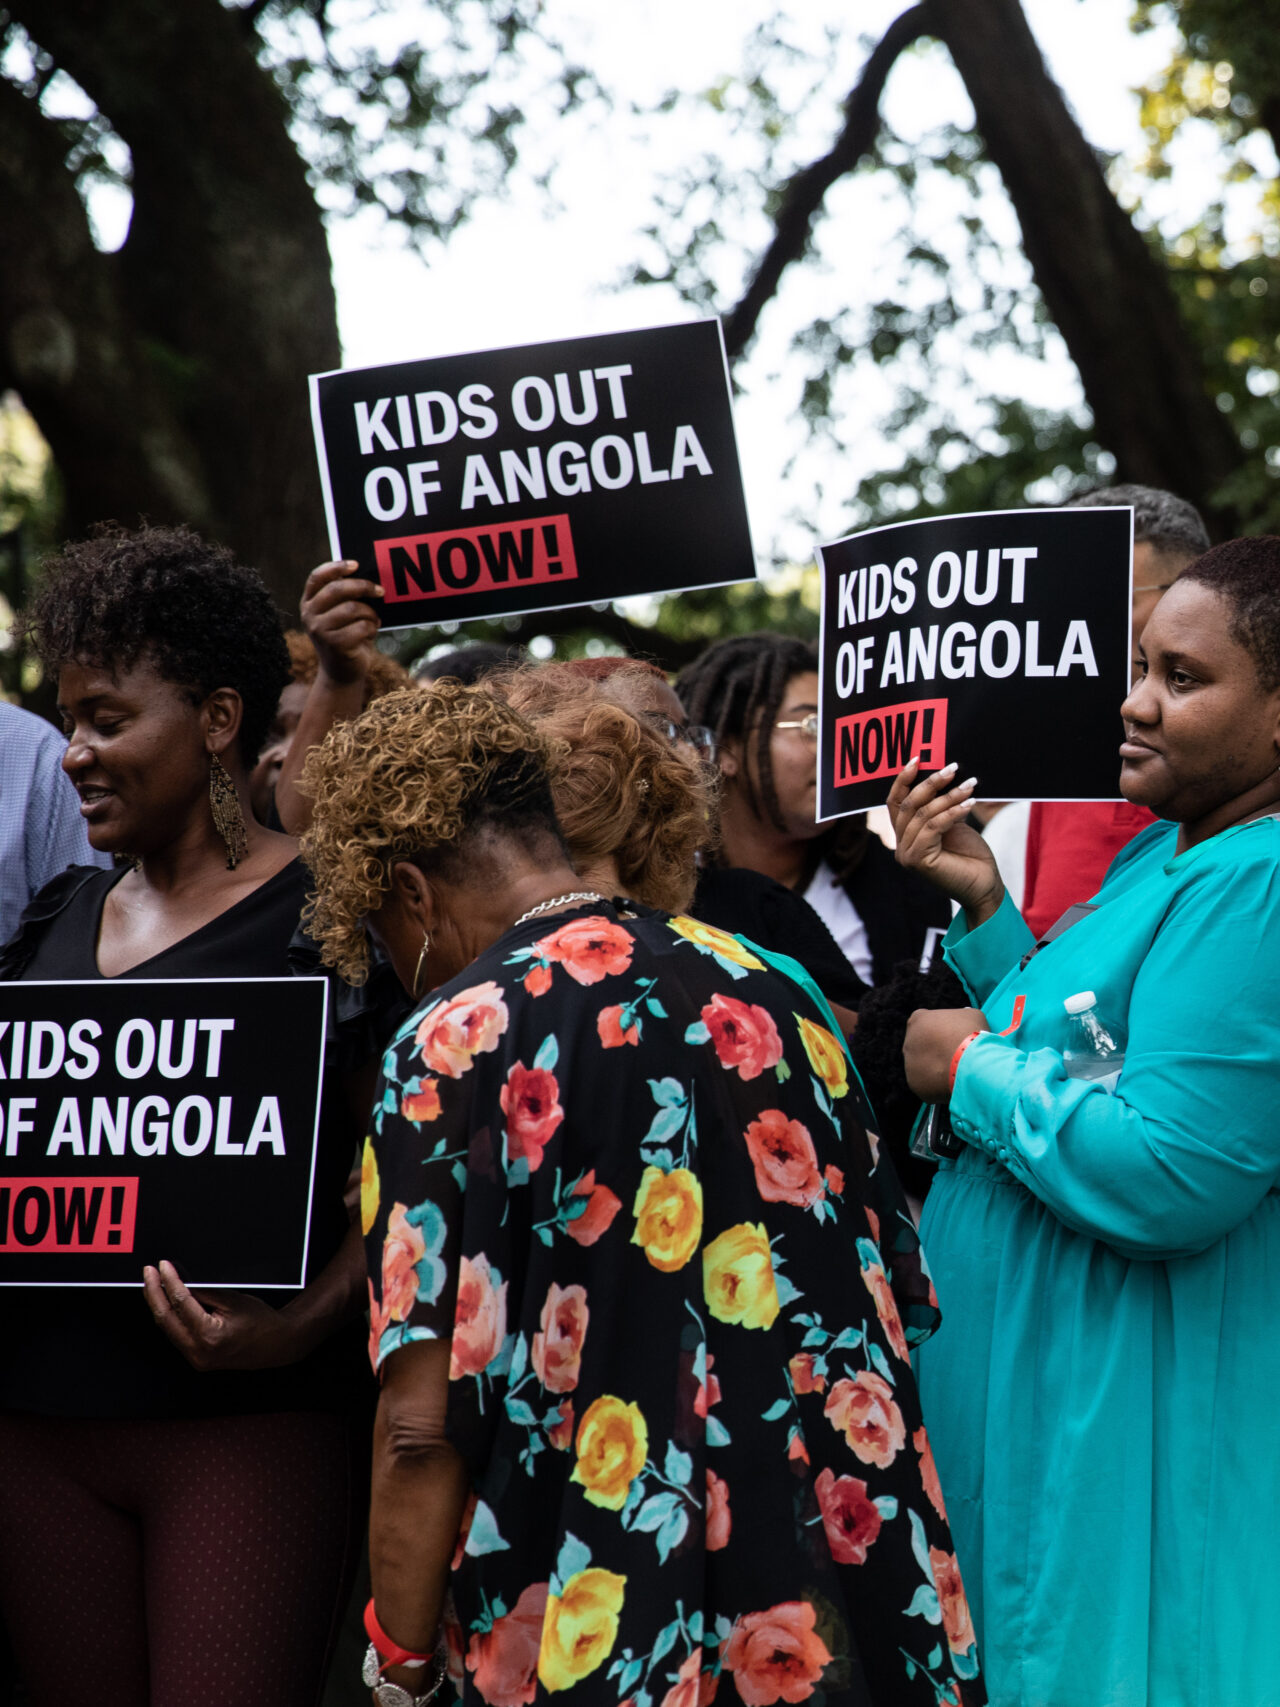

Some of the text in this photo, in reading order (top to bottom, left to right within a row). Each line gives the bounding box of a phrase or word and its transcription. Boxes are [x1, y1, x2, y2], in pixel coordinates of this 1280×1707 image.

[354, 364, 633, 455] KIDS OUT
[364, 425, 713, 521] OF ANGOLA
[388, 524, 563, 596] NOW!
[838, 547, 1038, 628] KIDS OUT
[835, 620, 1100, 699] OF ANGOLA
[839, 708, 935, 779] NOW!
[0, 1018, 235, 1080] IDS OUT
[0, 1095, 286, 1157] F ANGOLA
